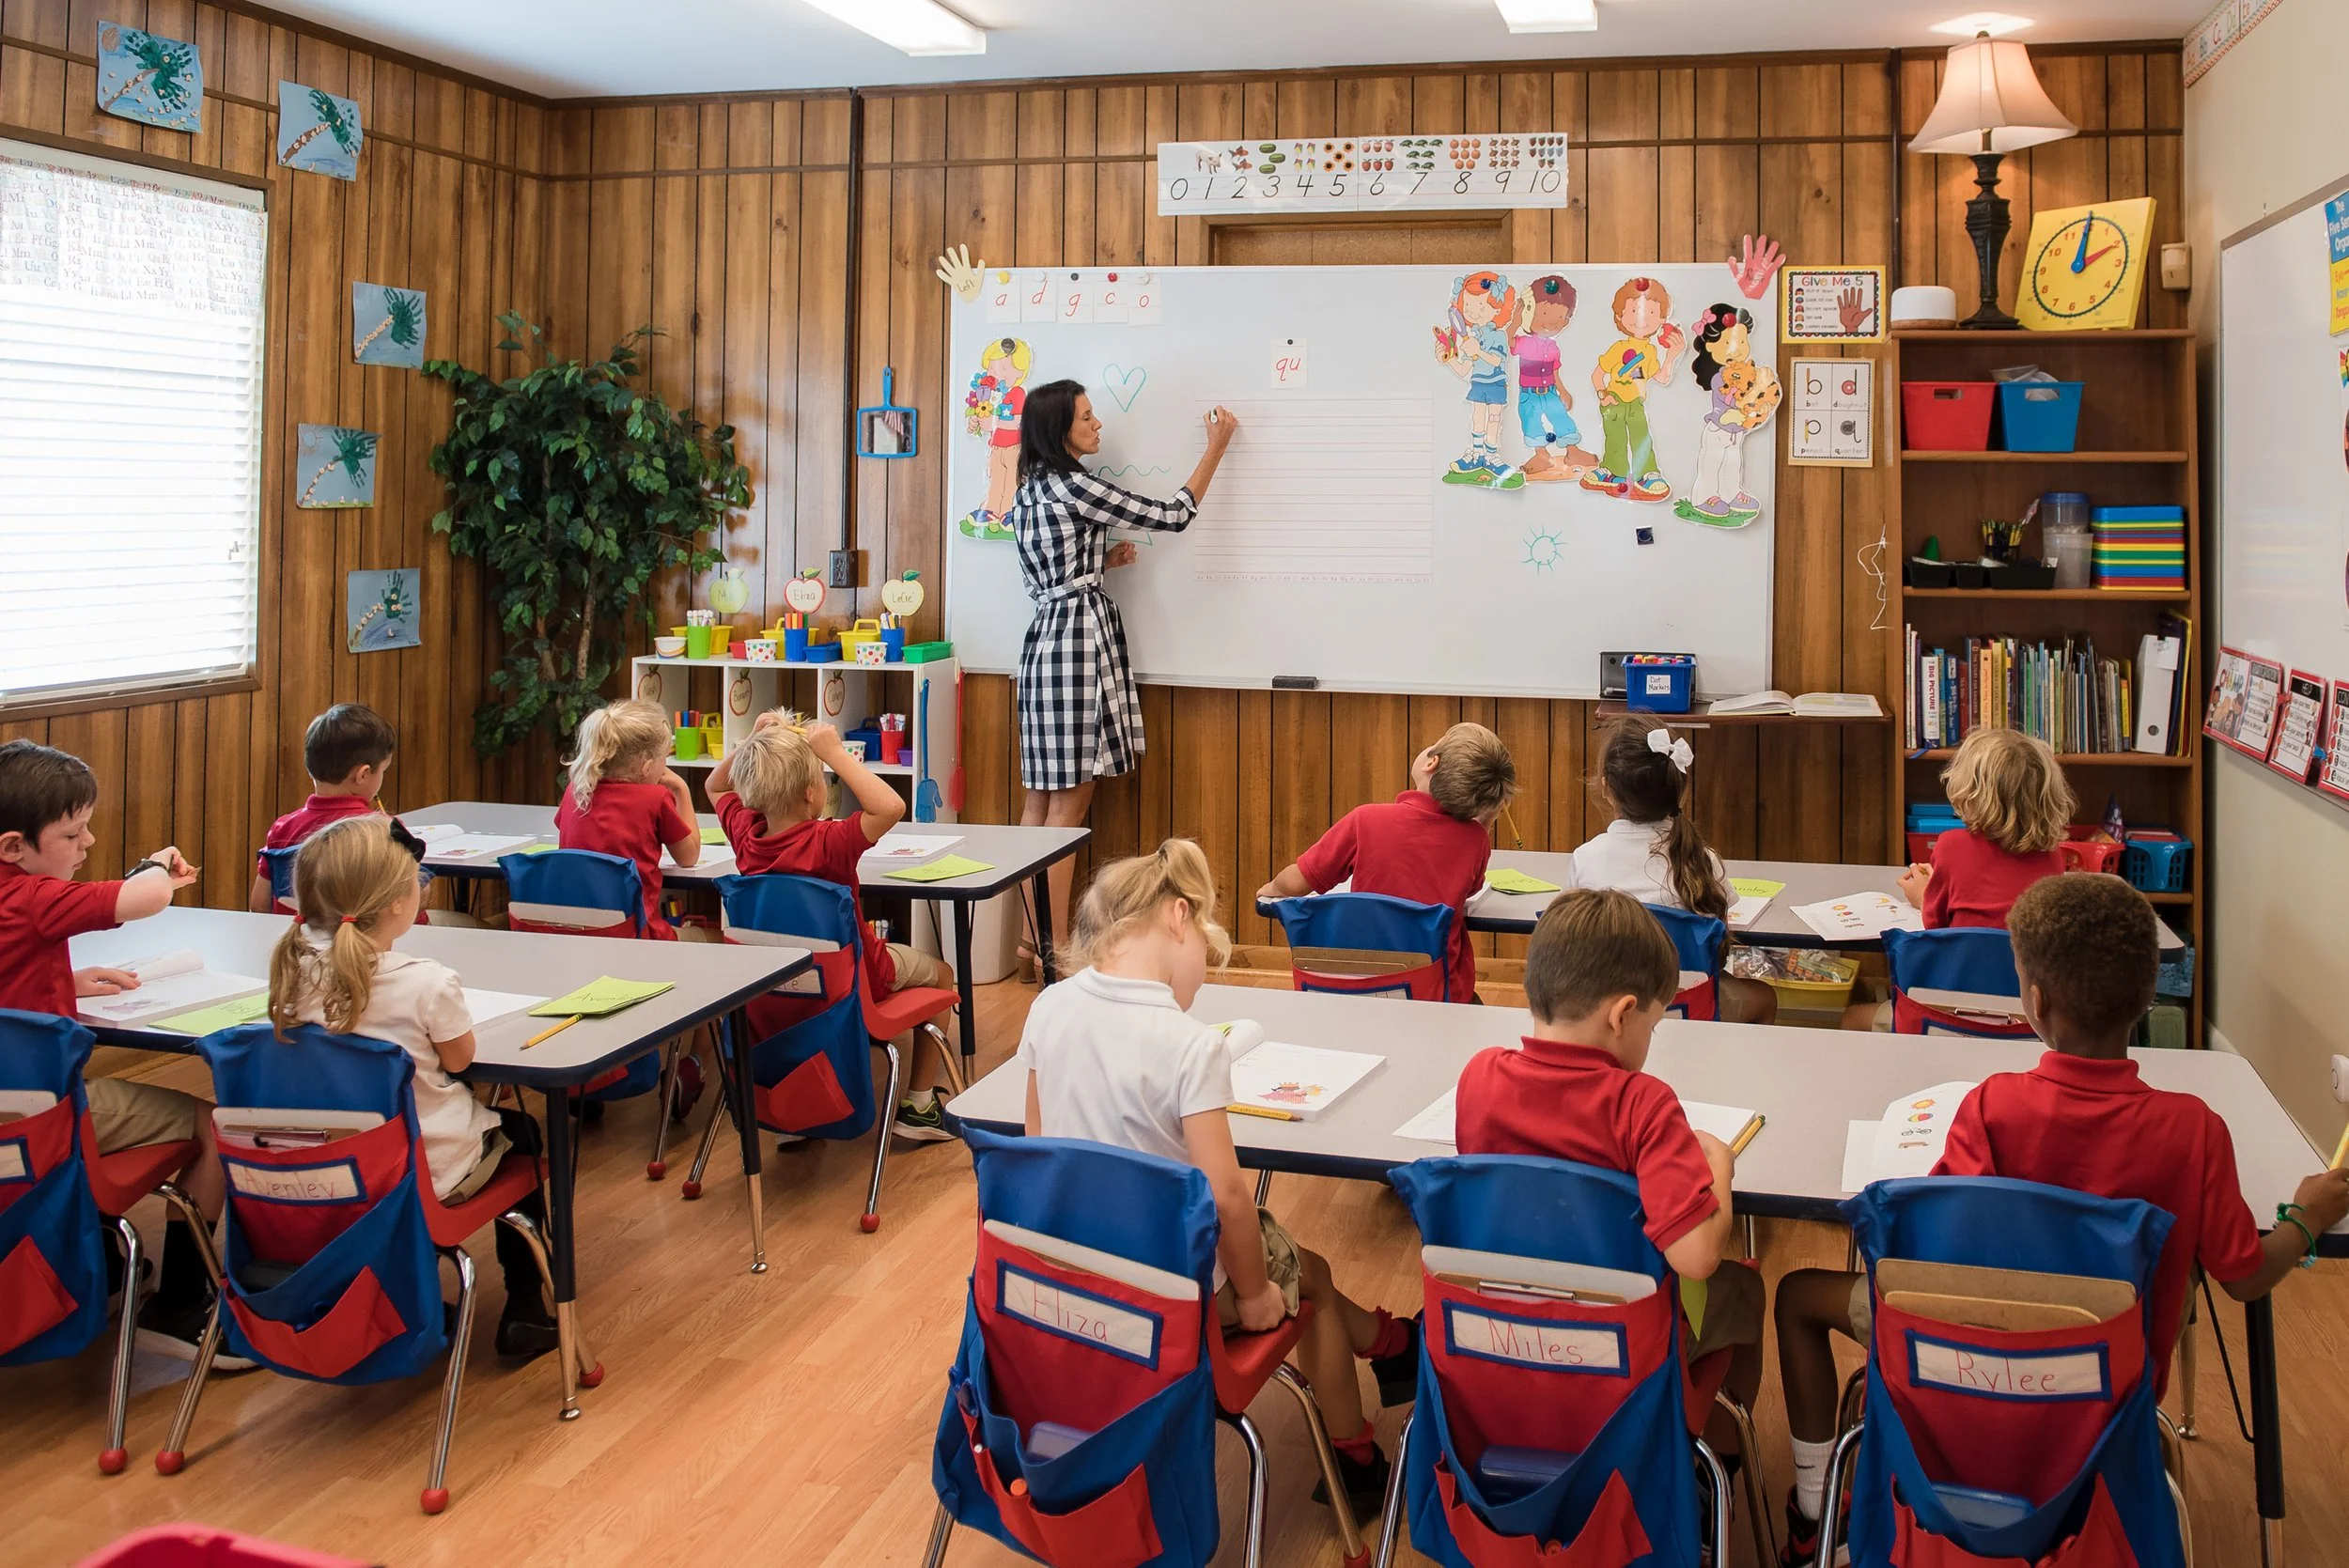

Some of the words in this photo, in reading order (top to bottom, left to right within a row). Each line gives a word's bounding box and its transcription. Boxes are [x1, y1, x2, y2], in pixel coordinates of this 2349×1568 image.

[1170, 178, 1189, 201] 0
[1204, 178, 1214, 200] 1
[1231, 177, 1249, 199] 2
[1262, 176, 1280, 198] 3
[1297, 175, 1315, 197] 4
[1329, 174, 1347, 197] 5
[1369, 173, 1385, 195] 6
[1410, 172, 1427, 195] 7
[1454, 172, 1471, 194] 8
[1494, 171, 1510, 194] 9
[1530, 170, 1562, 194] 10
[2063, 232, 2076, 241] 11
[2104, 227, 2109, 236] 1
[2112, 240, 2121, 249] 2
[2049, 248, 2061, 258] 10
[2114, 258, 2123, 268] 3
[2040, 266, 2046, 276] 9
[1832, 275, 1851, 287] Me
[1855, 275, 1864, 287] 5
[2104, 280, 2112, 289] 4
[2041, 285, 2048, 295] 8
[994, 290, 1009, 307] a
[1031, 281, 1048, 305] d
[1066, 290, 1081, 318] g
[1105, 290, 1115, 305] c
[1139, 292, 1149, 309] o
[2052, 298, 2060, 308] 7
[2089, 294, 2096, 304] 5
[2068, 302, 2076, 312] 6
[1275, 356, 1301, 382] qu
[1928, 679, 1937, 711] PICTURE
[1033, 1281, 1109, 1343] Eliza
[1487, 1317, 1585, 1365] Miles
[1955, 1350, 2058, 1393] Rylee
